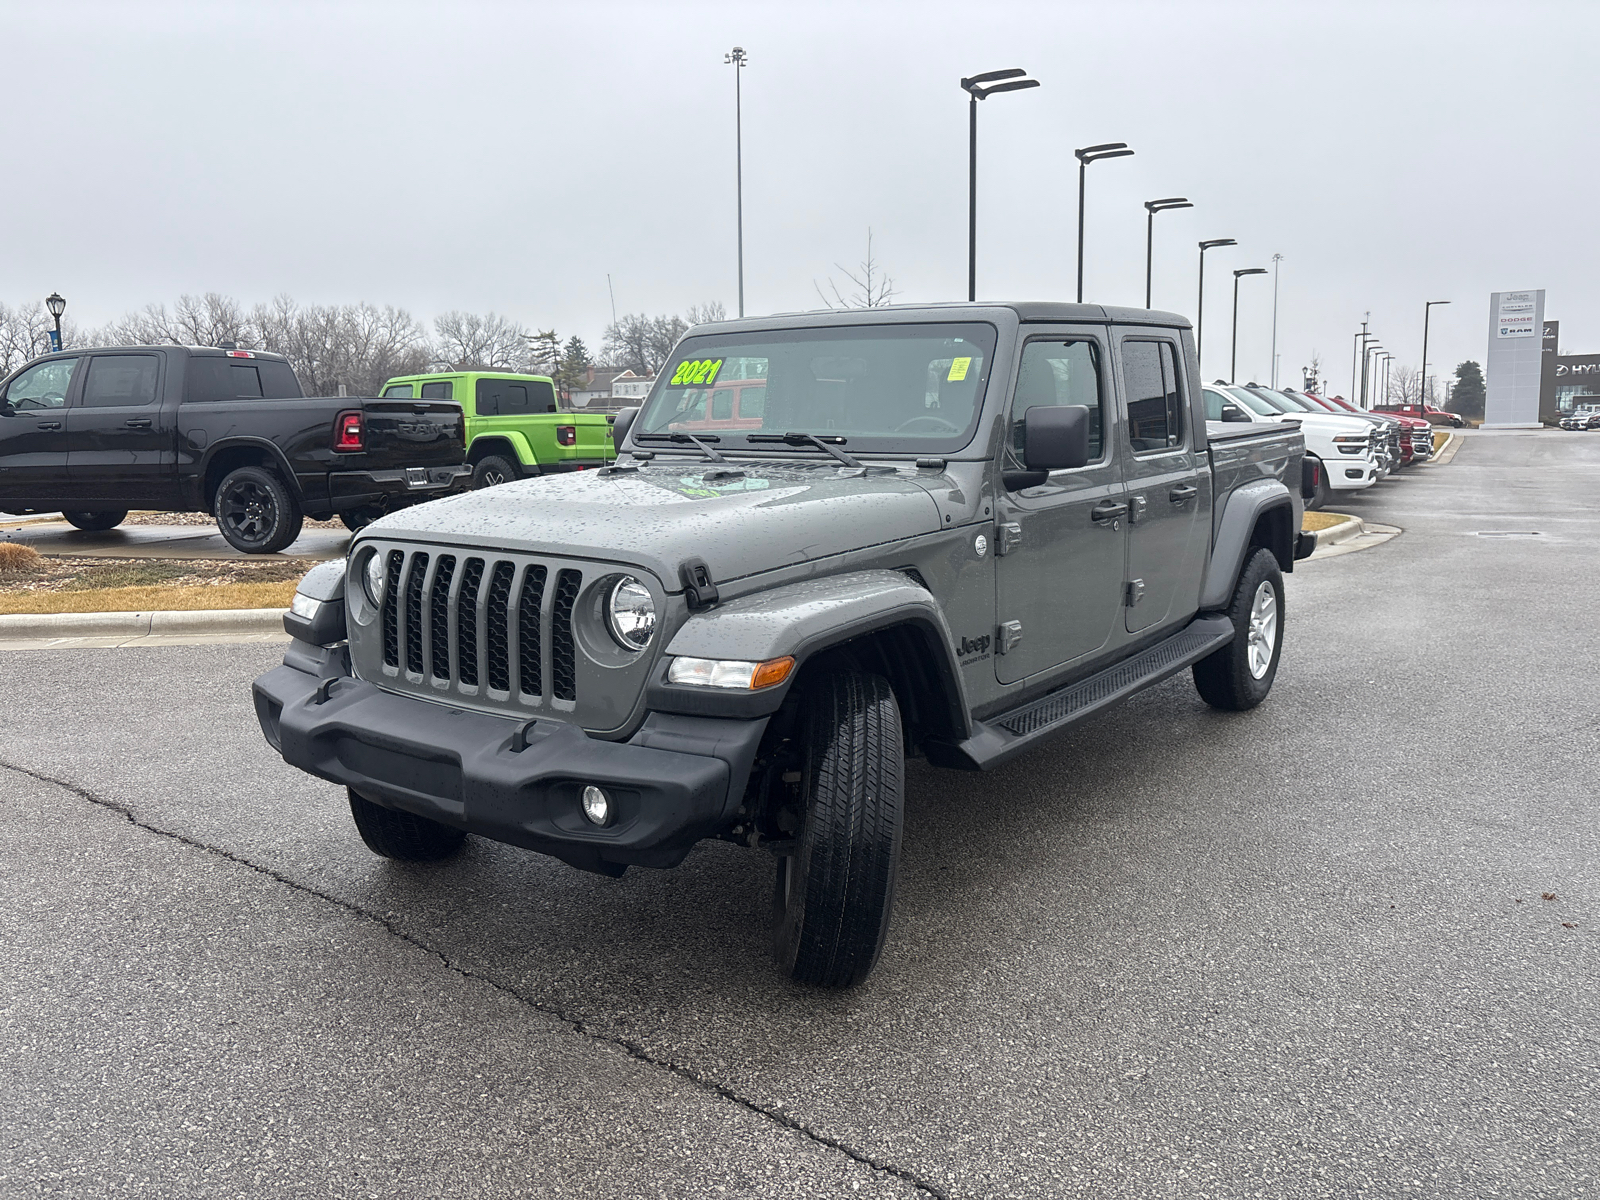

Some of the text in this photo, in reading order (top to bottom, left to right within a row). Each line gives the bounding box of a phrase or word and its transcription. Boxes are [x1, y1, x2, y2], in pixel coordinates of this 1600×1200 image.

[671, 359, 722, 385] 2021
[398, 423, 443, 434] RAM
[956, 634, 991, 657] Jeep
